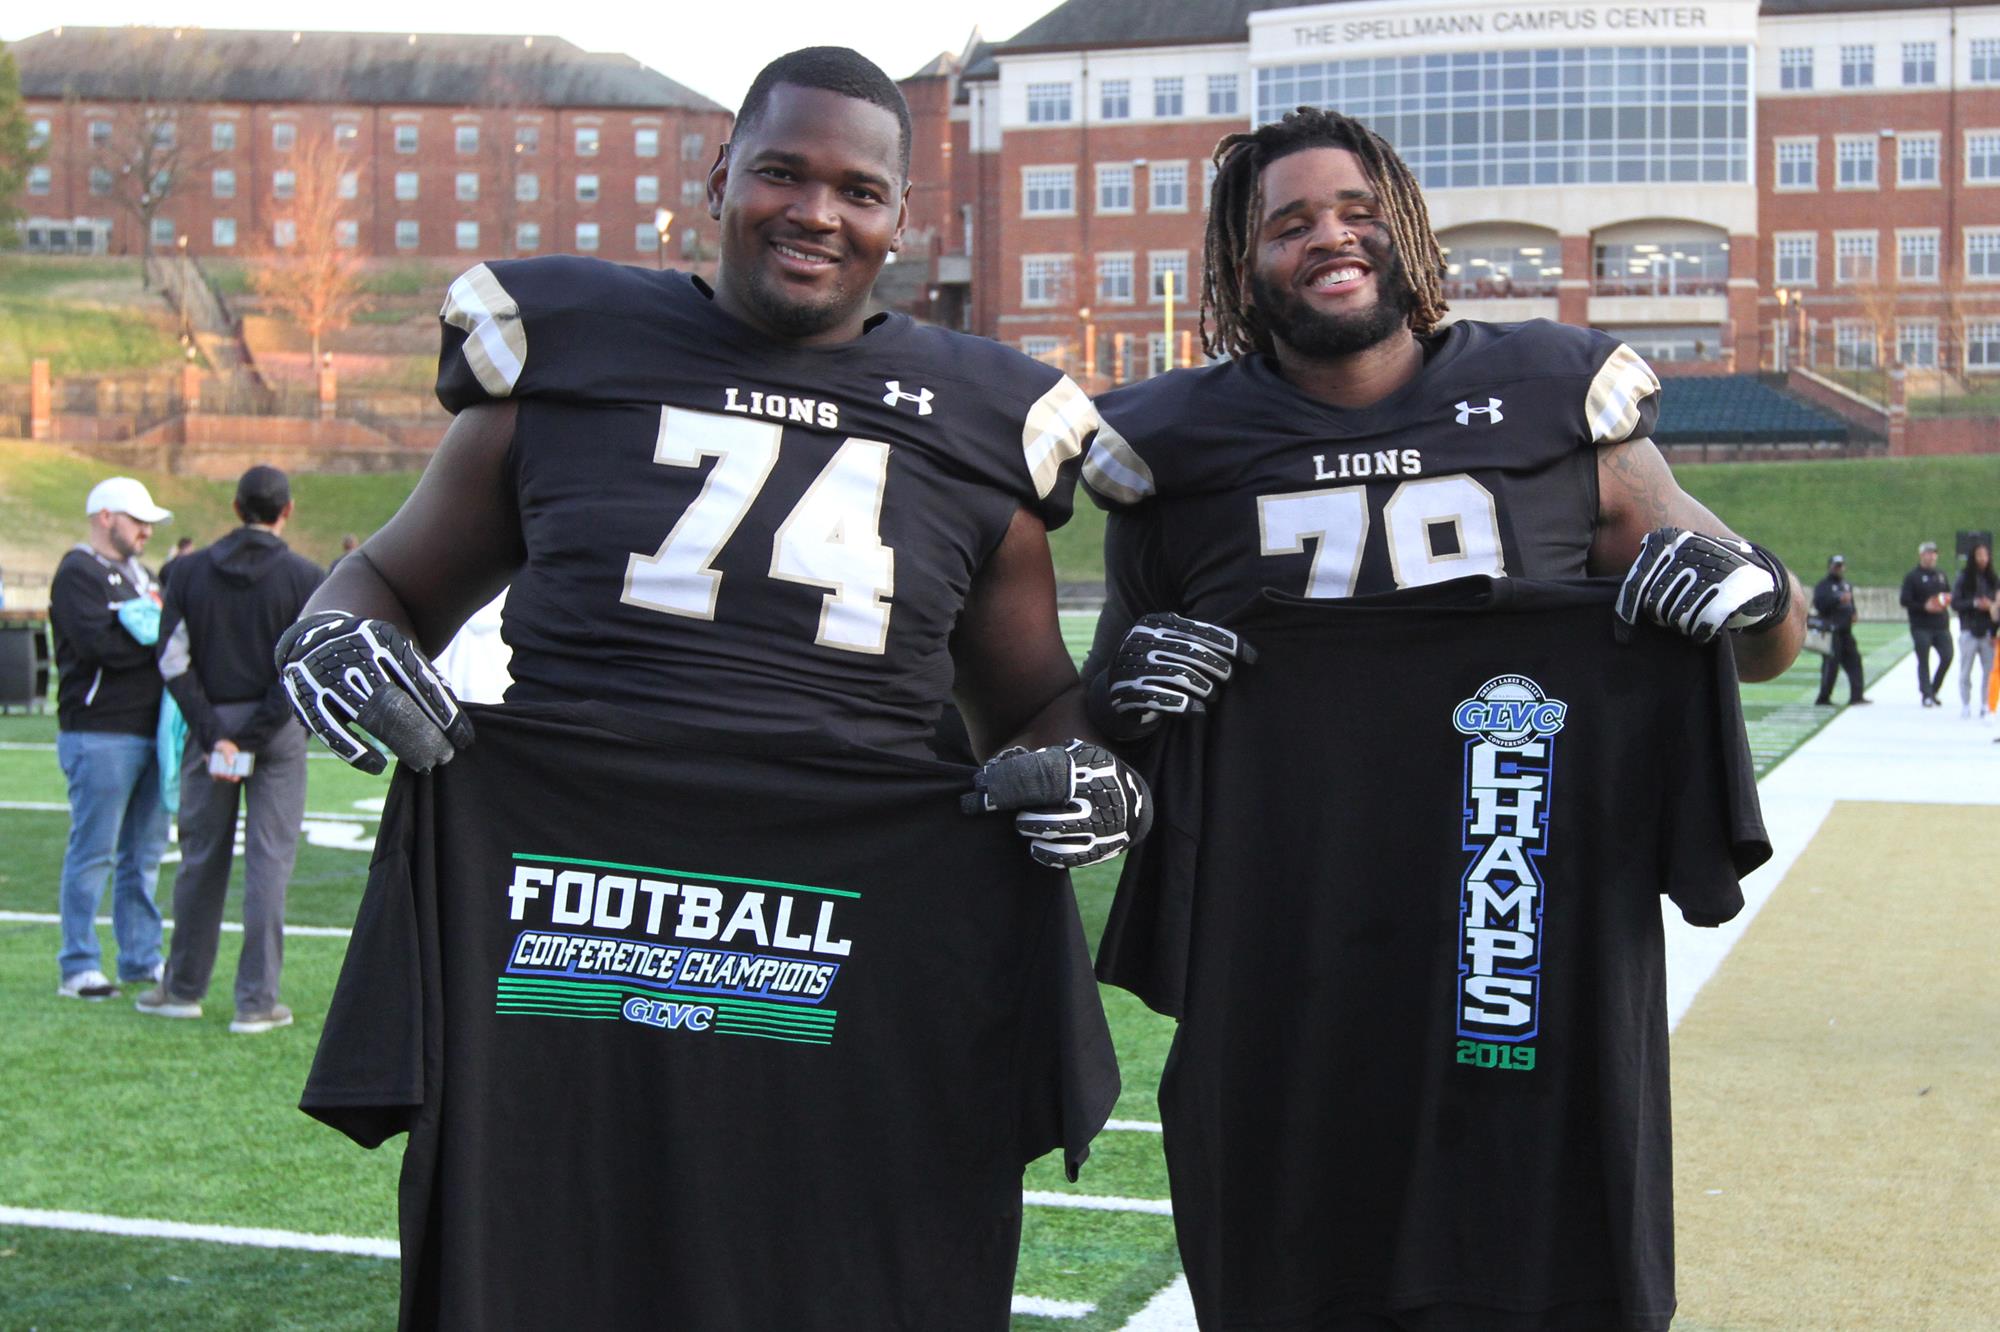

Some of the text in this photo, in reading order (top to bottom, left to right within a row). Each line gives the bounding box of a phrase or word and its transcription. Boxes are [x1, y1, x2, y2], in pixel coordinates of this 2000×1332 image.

[1293, 7, 1706, 45] THE SPELLMANN CAMPUS CENTER
[724, 388, 839, 429] LIONS
[1312, 449, 1422, 480] LIONS
[619, 404, 894, 655] 74
[1479, 677, 1542, 698] GREAT LAKES VALLEY
[1456, 700, 1565, 734] GLVC
[1487, 735, 1530, 747] CONFERENCE
[1464, 742, 1545, 1026] CHAMPS
[508, 866, 852, 956] FOOTBALL
[513, 934, 834, 995] CONFERENCE CHAMPIONS
[623, 997, 714, 1031] GLVC
[1456, 1040, 1535, 1071] 2019
